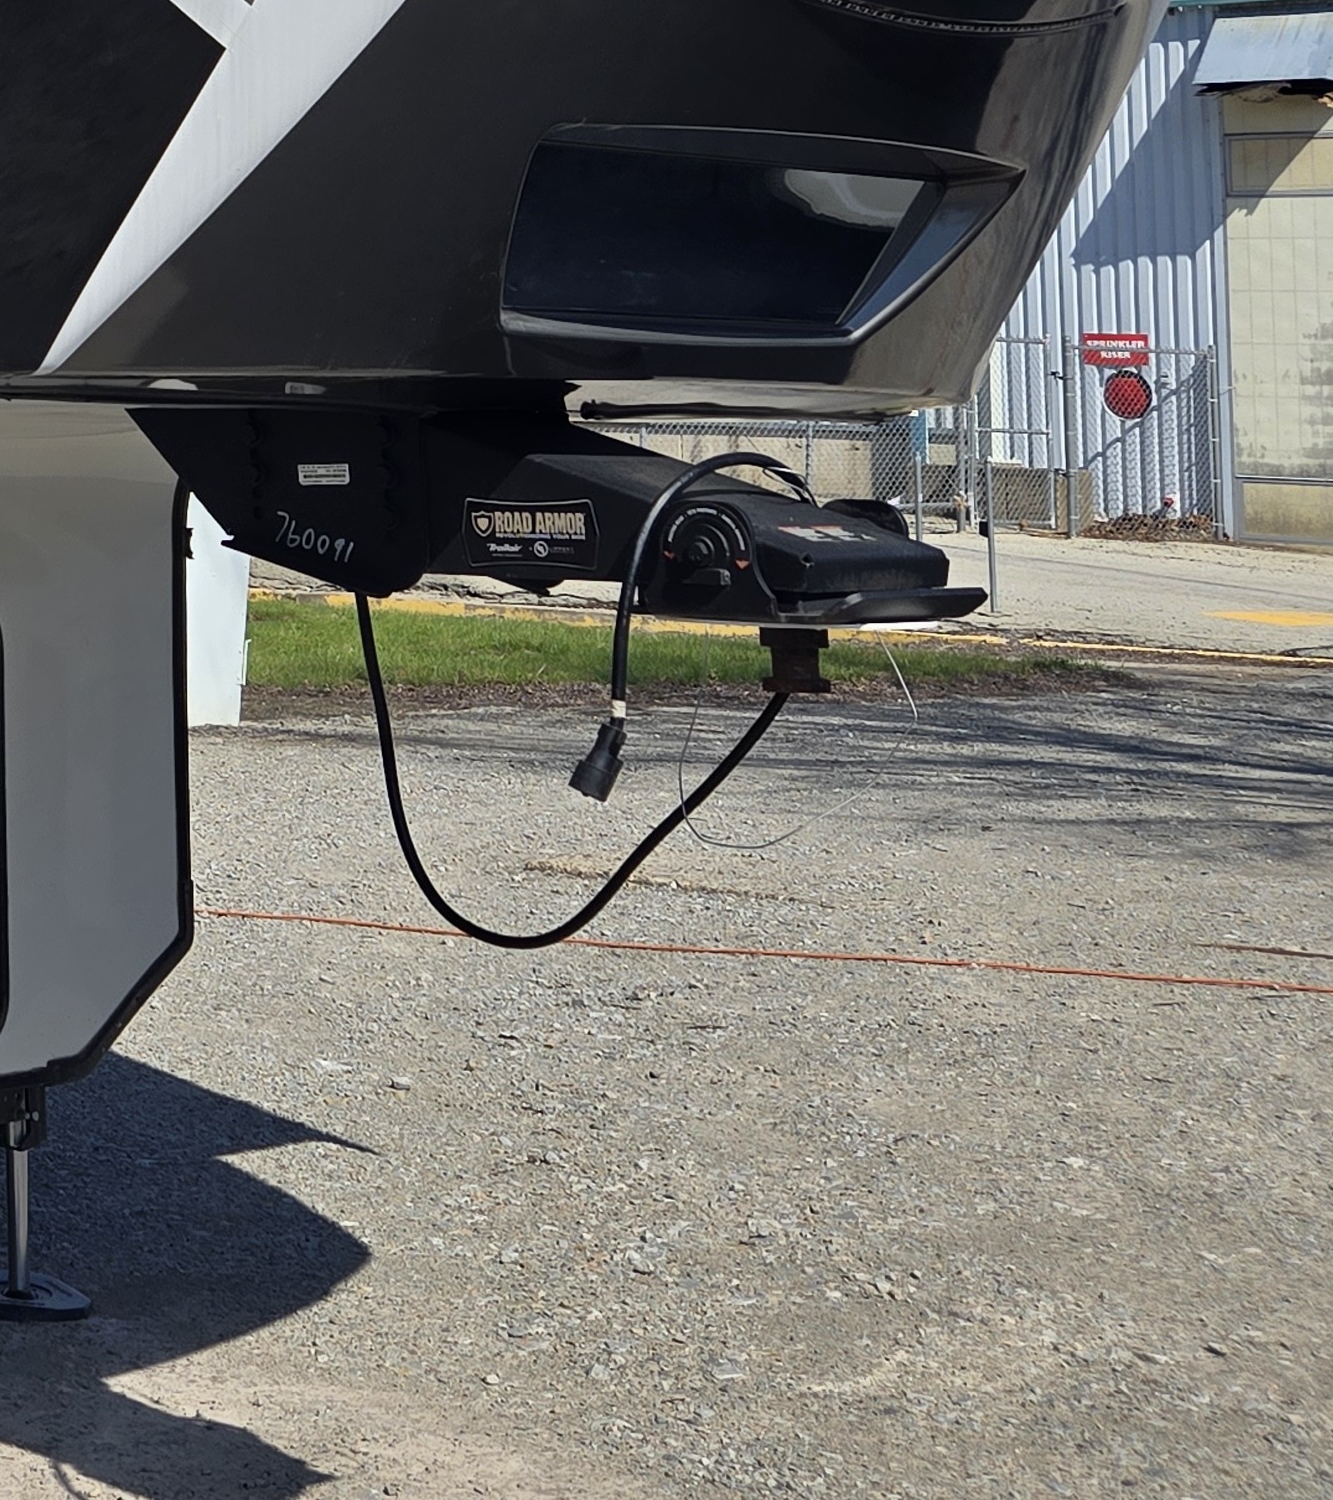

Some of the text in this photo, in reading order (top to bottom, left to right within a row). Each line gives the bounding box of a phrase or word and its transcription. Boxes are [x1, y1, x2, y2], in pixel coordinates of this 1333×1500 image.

[276, 510, 355, 563] 760091
[494, 511, 586, 534] ROAD ARMOR
